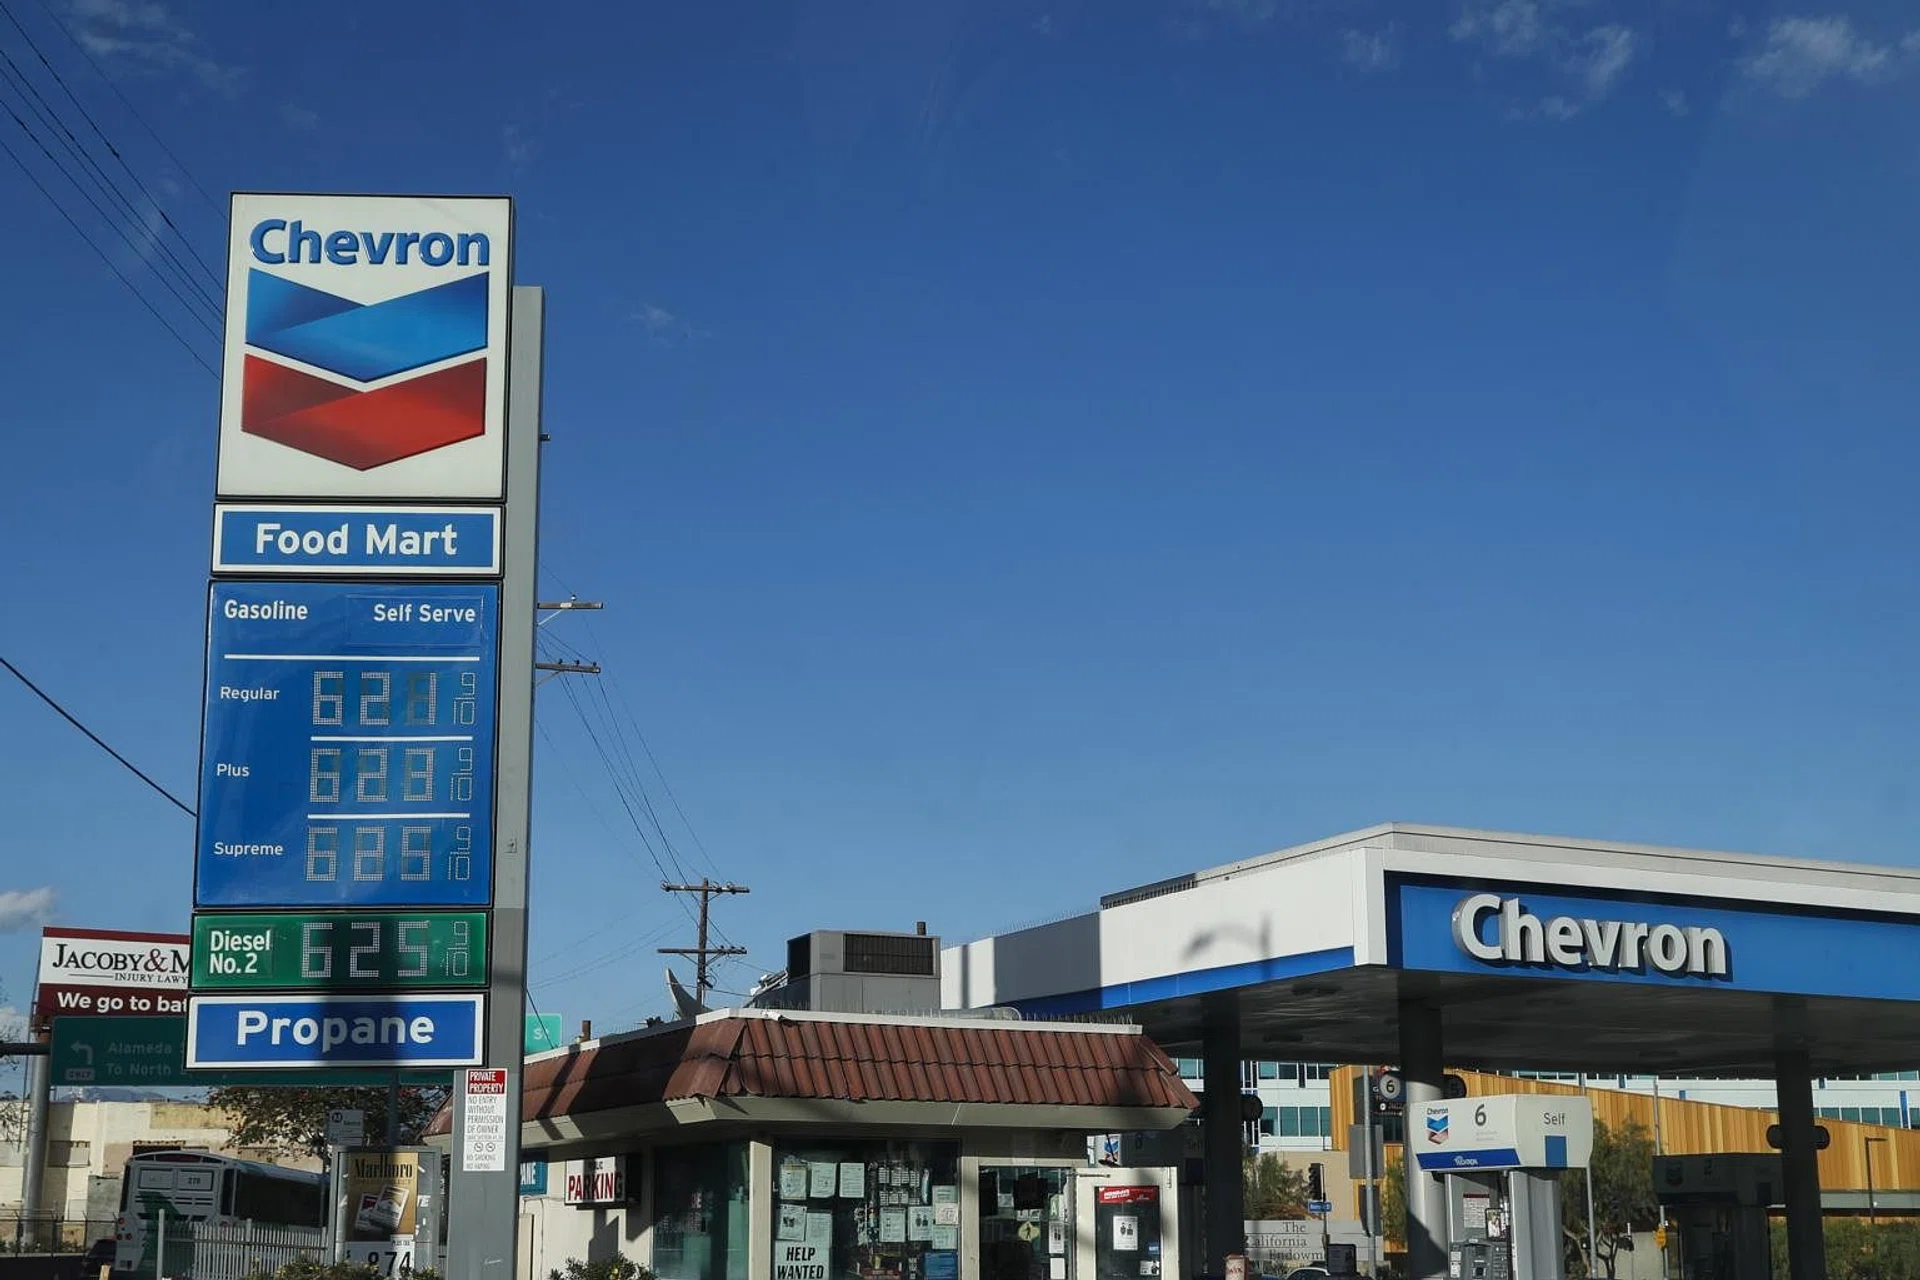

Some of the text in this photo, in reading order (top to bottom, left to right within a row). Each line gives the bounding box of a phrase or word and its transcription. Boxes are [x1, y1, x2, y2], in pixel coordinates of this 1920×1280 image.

[249, 218, 490, 266] Chevron
[255, 523, 458, 555] Food Mart
[224, 600, 476, 623] Gasoline Self Serve
[220, 686, 280, 702] Regular
[217, 763, 249, 777] Plus
[214, 842, 284, 857] Supreme
[1452, 893, 1727, 974] Chevron
[210, 930, 271, 951] Diesel
[301, 921, 430, 978] 625
[209, 953, 241, 974] No.
[245, 953, 258, 974] 2
[114, 972, 154, 983] INJURY
[57, 991, 91, 1009] We
[97, 996, 124, 1013] go
[130, 996, 151, 1011] to
[237, 1010, 435, 1053] Propane
[107, 1041, 172, 1055] Alameda
[106, 1063, 122, 1076] To
[129, 1063, 172, 1076] North
[470, 1071, 496, 1081] PRIVATE
[469, 1082, 503, 1093] PROPERTY
[1386, 1080, 1395, 1093] 6
[468, 1096, 477, 1104] NO
[467, 1115, 504, 1124] PERMISSION
[1474, 1103, 1487, 1126] 6
[1543, 1112, 1566, 1126] Self
[355, 1152, 413, 1178] Marlboro
[568, 1171, 623, 1201] PARKING
[1282, 1221, 1306, 1233] The
[1251, 1235, 1307, 1248] alifornia
[786, 1246, 816, 1261] HELP
[777, 1265, 824, 1280] WANTED
